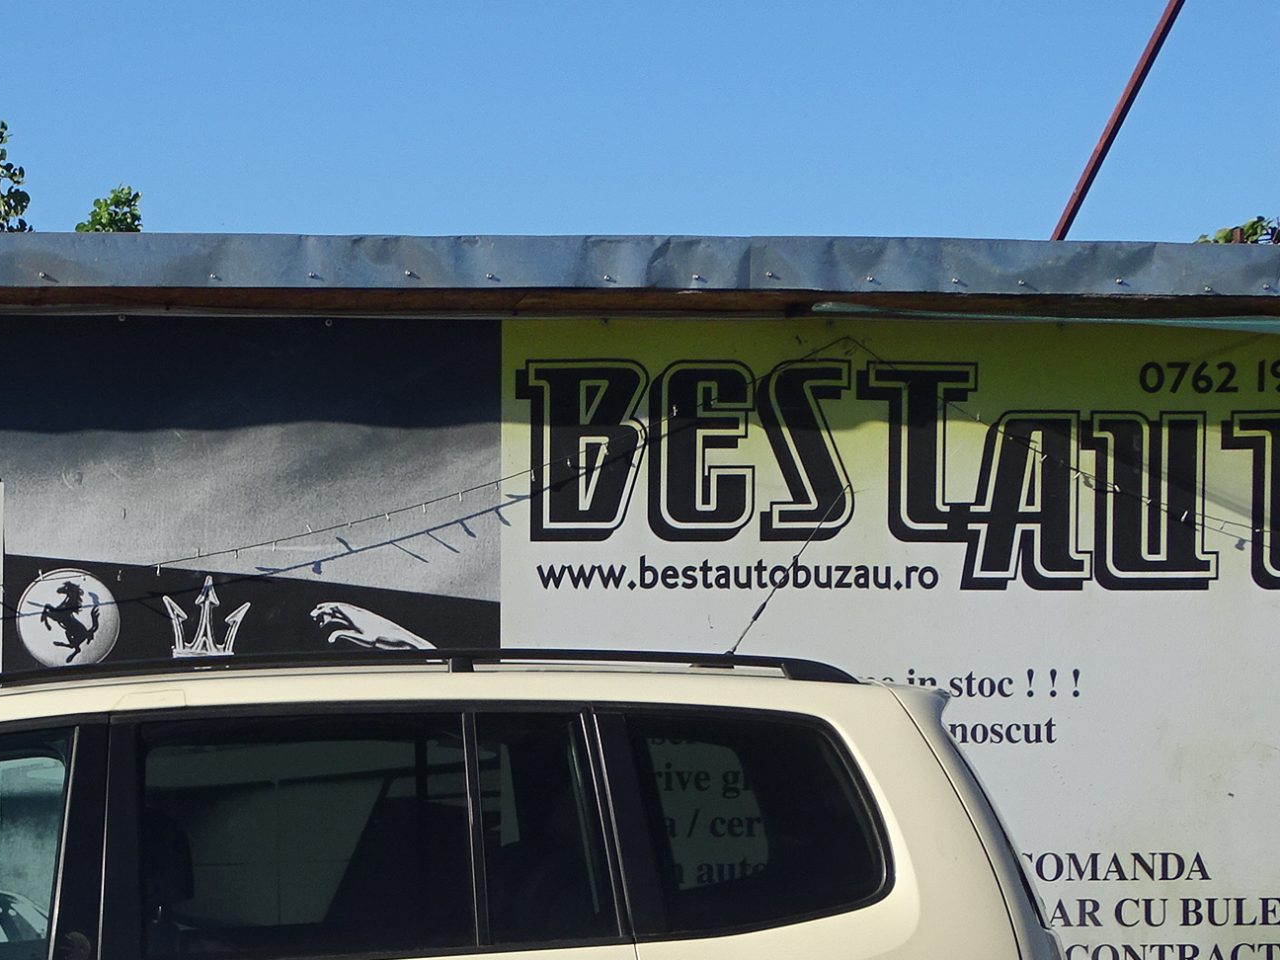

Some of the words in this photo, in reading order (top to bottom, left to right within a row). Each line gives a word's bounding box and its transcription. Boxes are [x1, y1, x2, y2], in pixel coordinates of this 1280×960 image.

[1140, 361, 1239, 393] 0762
[537, 555, 939, 590] www.bestautobuzau.ro
[949, 671, 1014, 698] stoc
[948, 717, 1057, 744] noscut
[1022, 851, 1212, 882] OMANDA
[1114, 898, 1169, 927] CU
[1179, 897, 1280, 926] BULE
